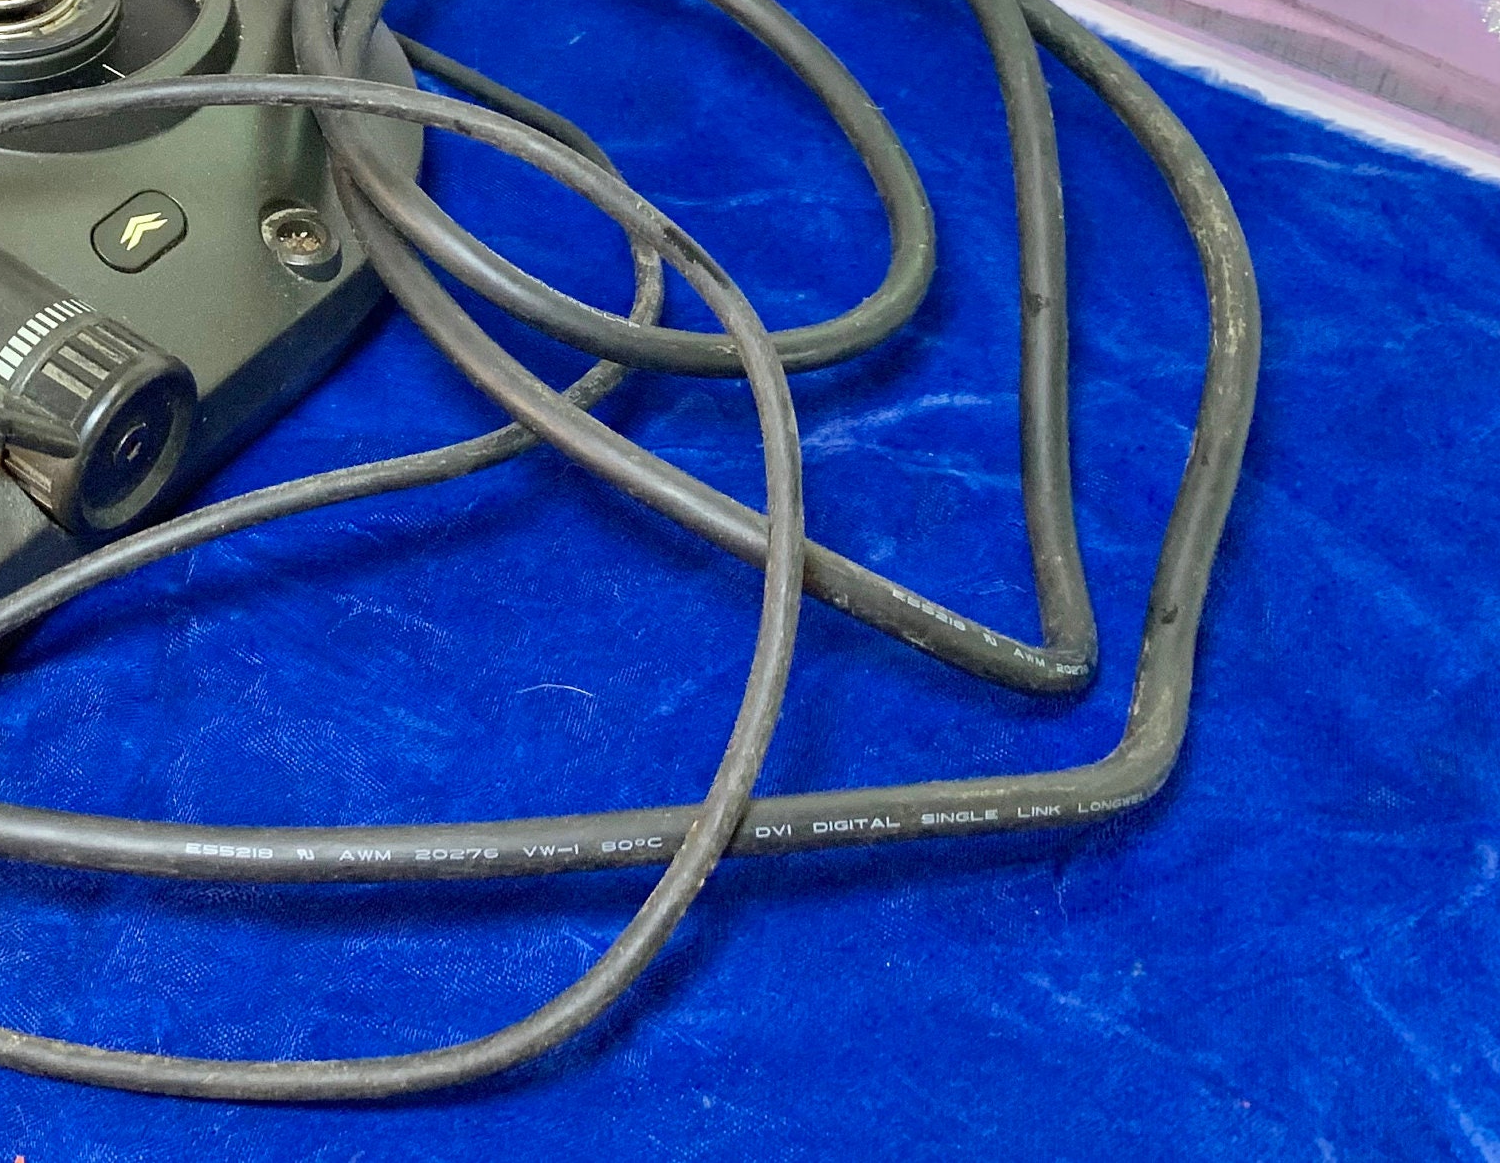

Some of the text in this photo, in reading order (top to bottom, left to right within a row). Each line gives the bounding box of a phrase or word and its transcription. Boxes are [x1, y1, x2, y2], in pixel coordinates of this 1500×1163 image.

[1013, 647, 1046, 668] AWM
[755, 823, 792, 839] DVI
[812, 816, 901, 834] DIGITAL
[920, 808, 1000, 825] SINGLE
[1017, 804, 1061, 819] LINK
[185, 841, 274, 860] E55218
[339, 849, 392, 862] AWM
[414, 847, 499, 862] 20276
[522, 843, 580, 858] VW-1
